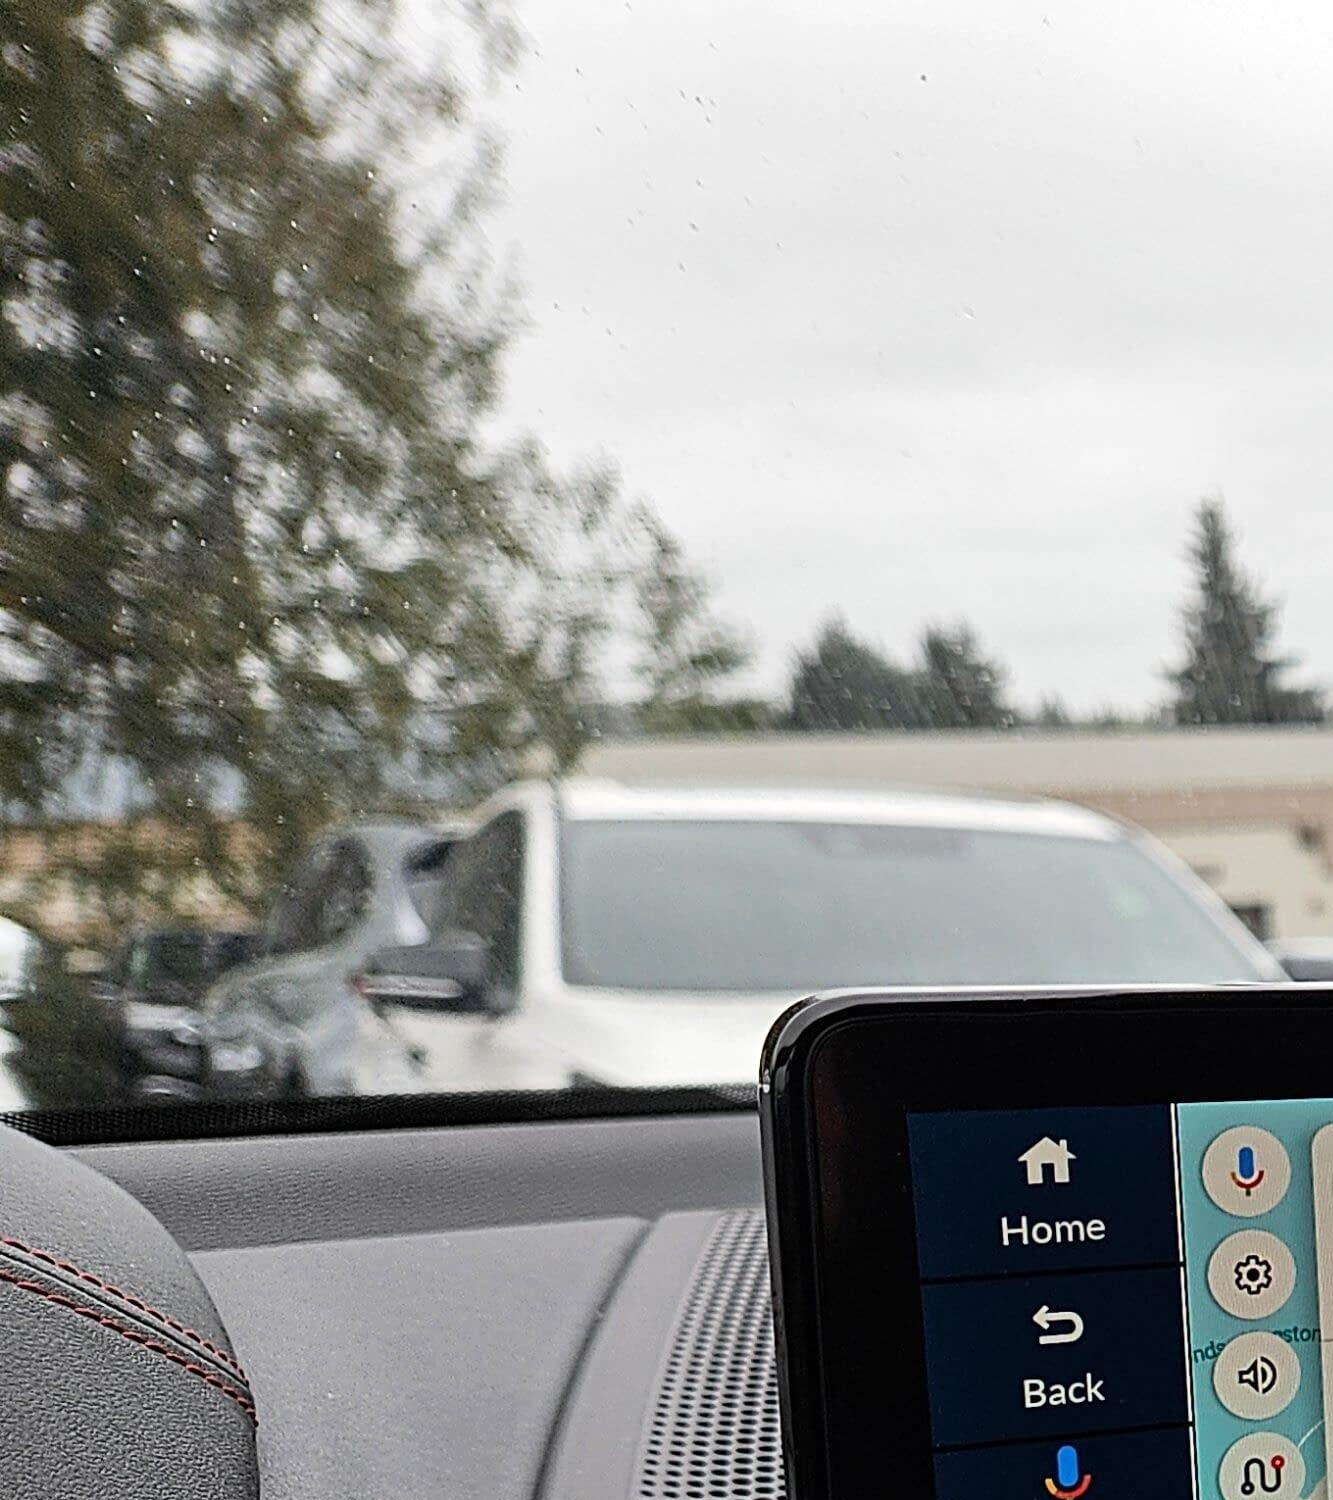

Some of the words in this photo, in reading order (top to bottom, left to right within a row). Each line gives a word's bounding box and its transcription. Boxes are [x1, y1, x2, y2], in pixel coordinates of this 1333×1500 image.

[1001, 1214, 1106, 1246] Home
[1273, 1326, 1321, 1343] ston
[1023, 1373, 1106, 1408] Back
